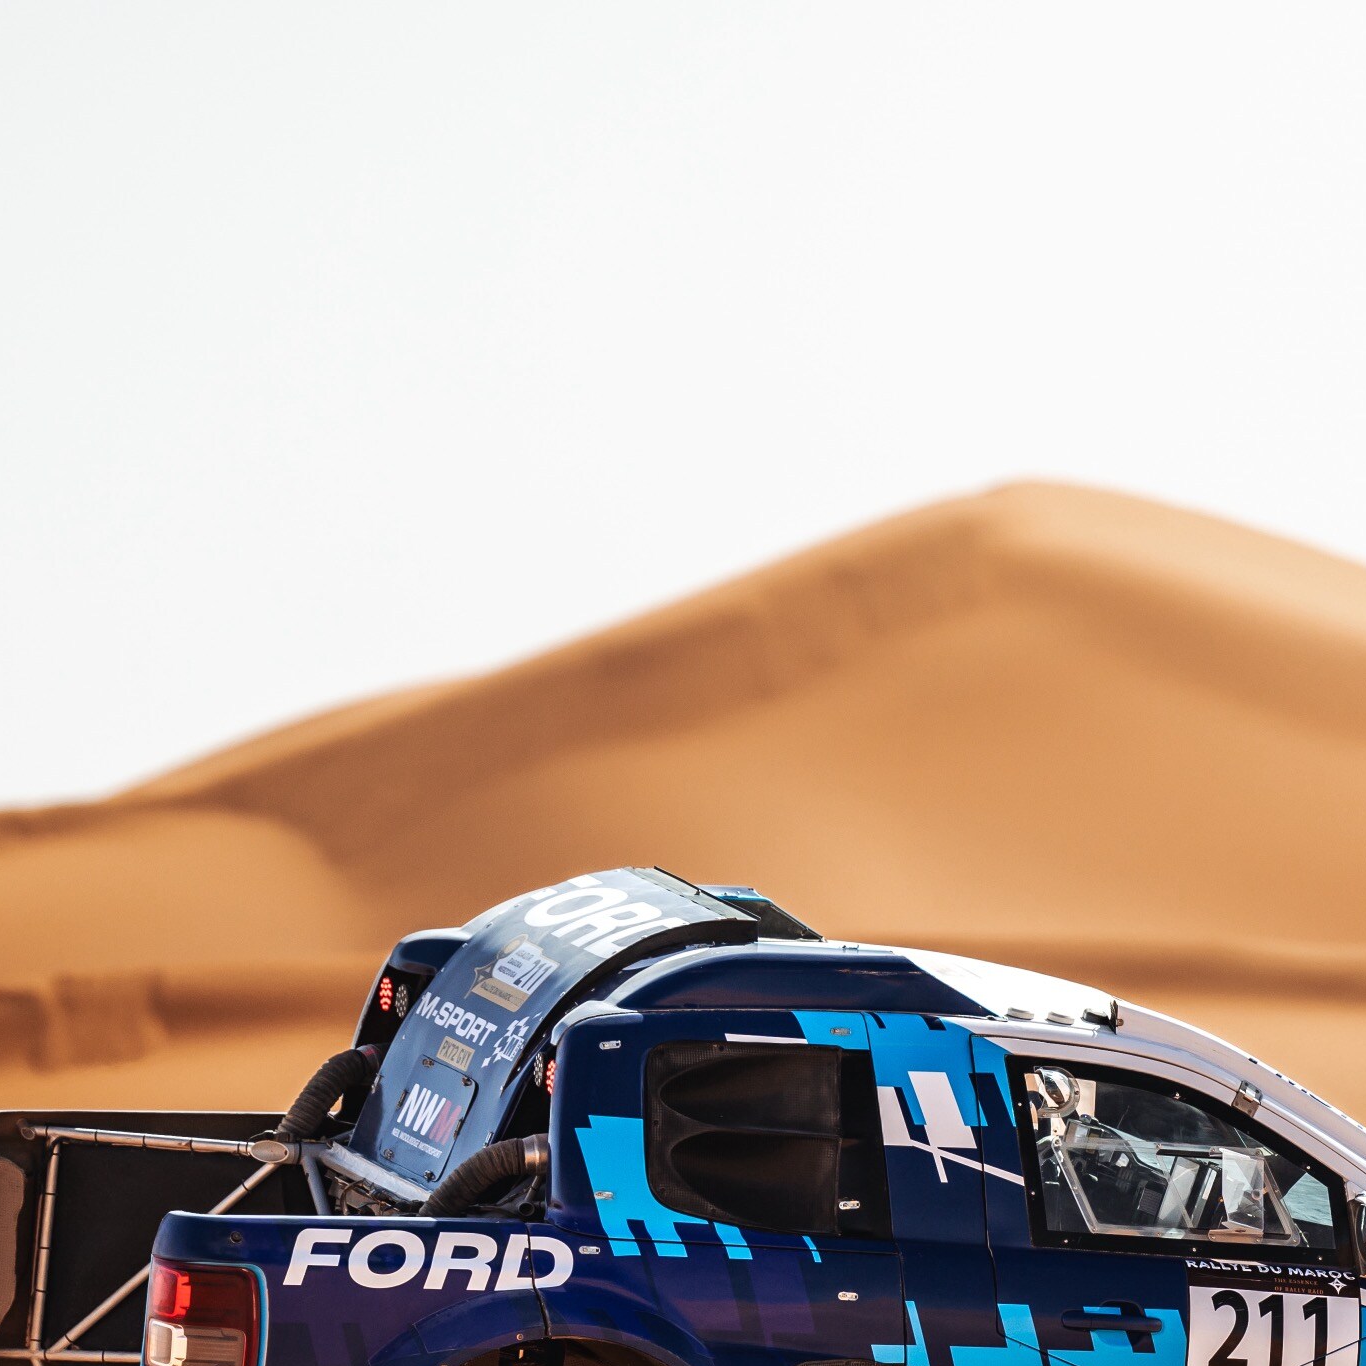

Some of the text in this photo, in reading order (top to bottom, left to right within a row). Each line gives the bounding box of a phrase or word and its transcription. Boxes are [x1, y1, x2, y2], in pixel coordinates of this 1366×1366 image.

[513, 959, 553, 992] 211
[415, 991, 498, 1046] M-SPORT
[396, 1083, 462, 1146] NWM
[282, 1228, 574, 1291] FORD
[1185, 1259, 1356, 1281] RALLYE DU MAROC
[1289, 1278, 1319, 1286] ESSENCE
